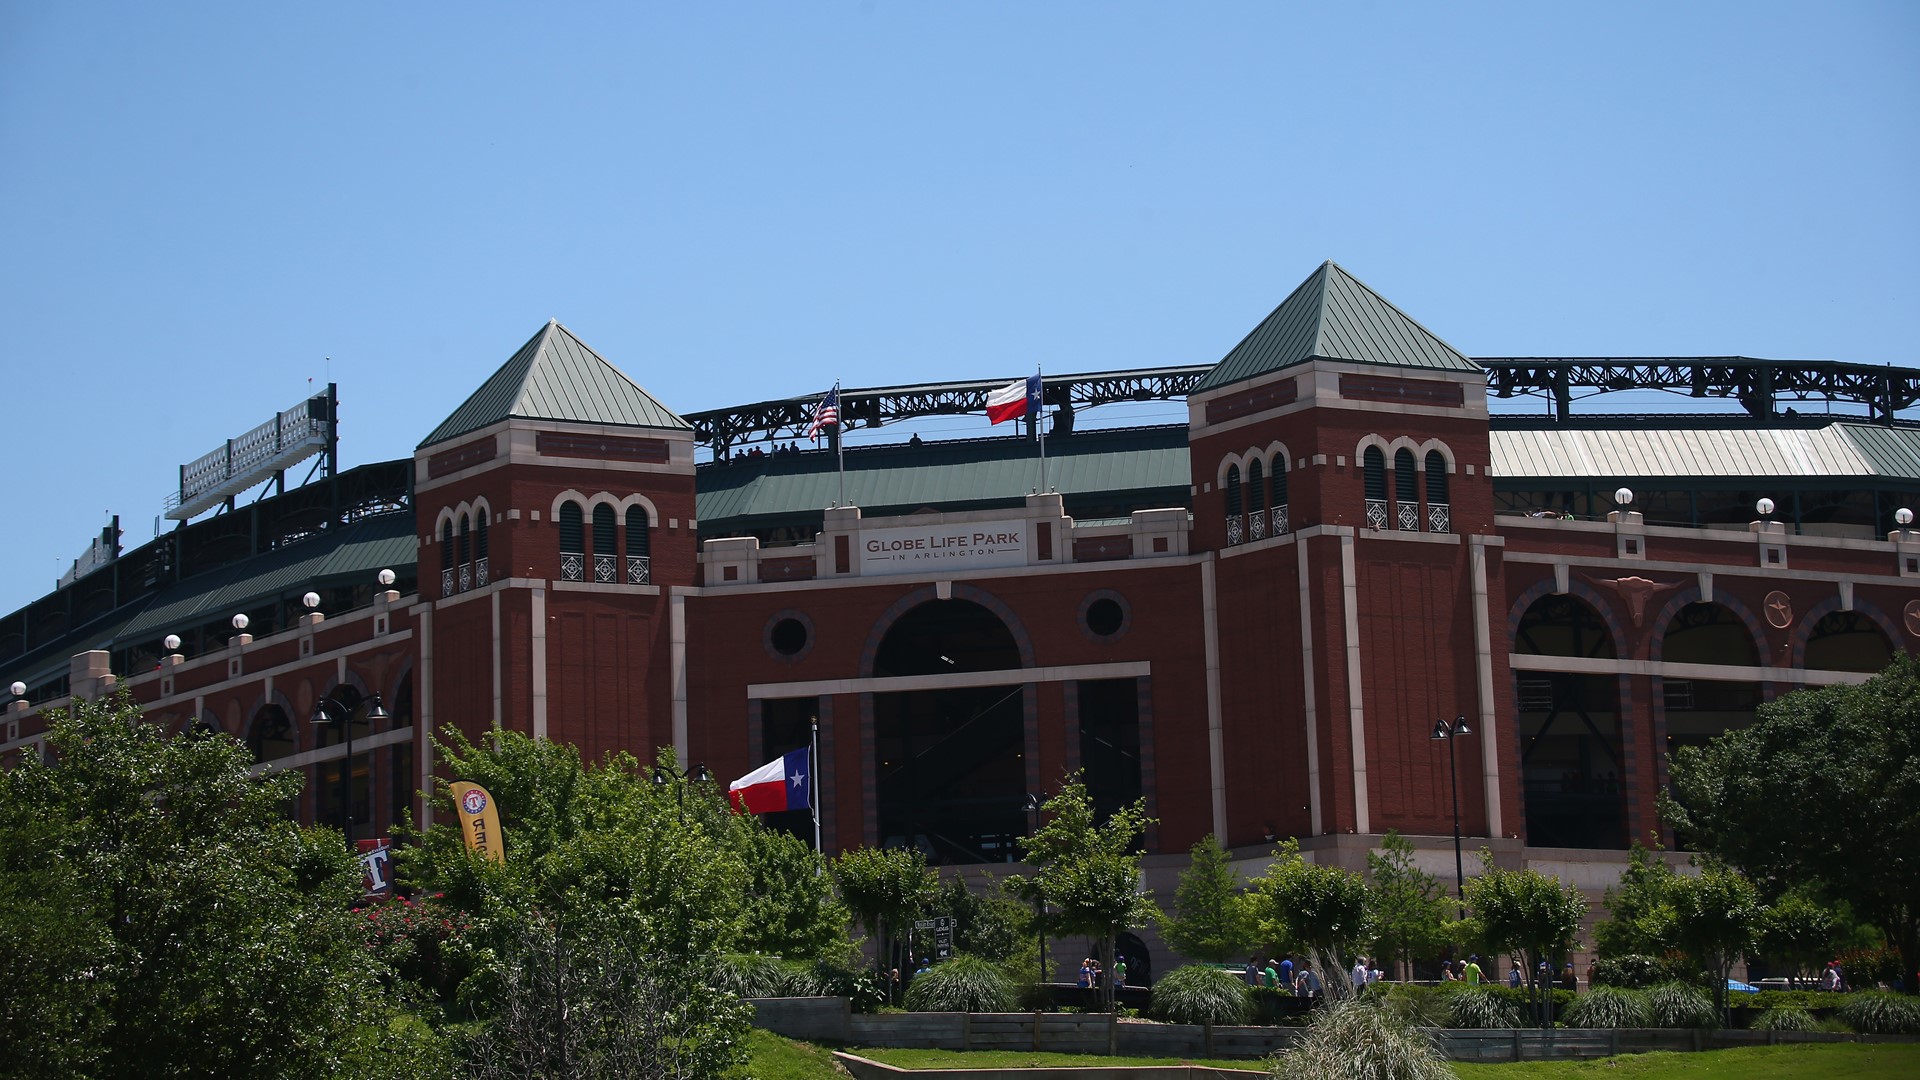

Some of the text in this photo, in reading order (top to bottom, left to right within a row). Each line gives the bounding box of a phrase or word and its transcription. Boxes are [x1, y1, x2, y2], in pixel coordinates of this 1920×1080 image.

[866, 532, 1019, 553] GLOBE LIFE PARK
[914, 548, 994, 560] ARLINGTON
